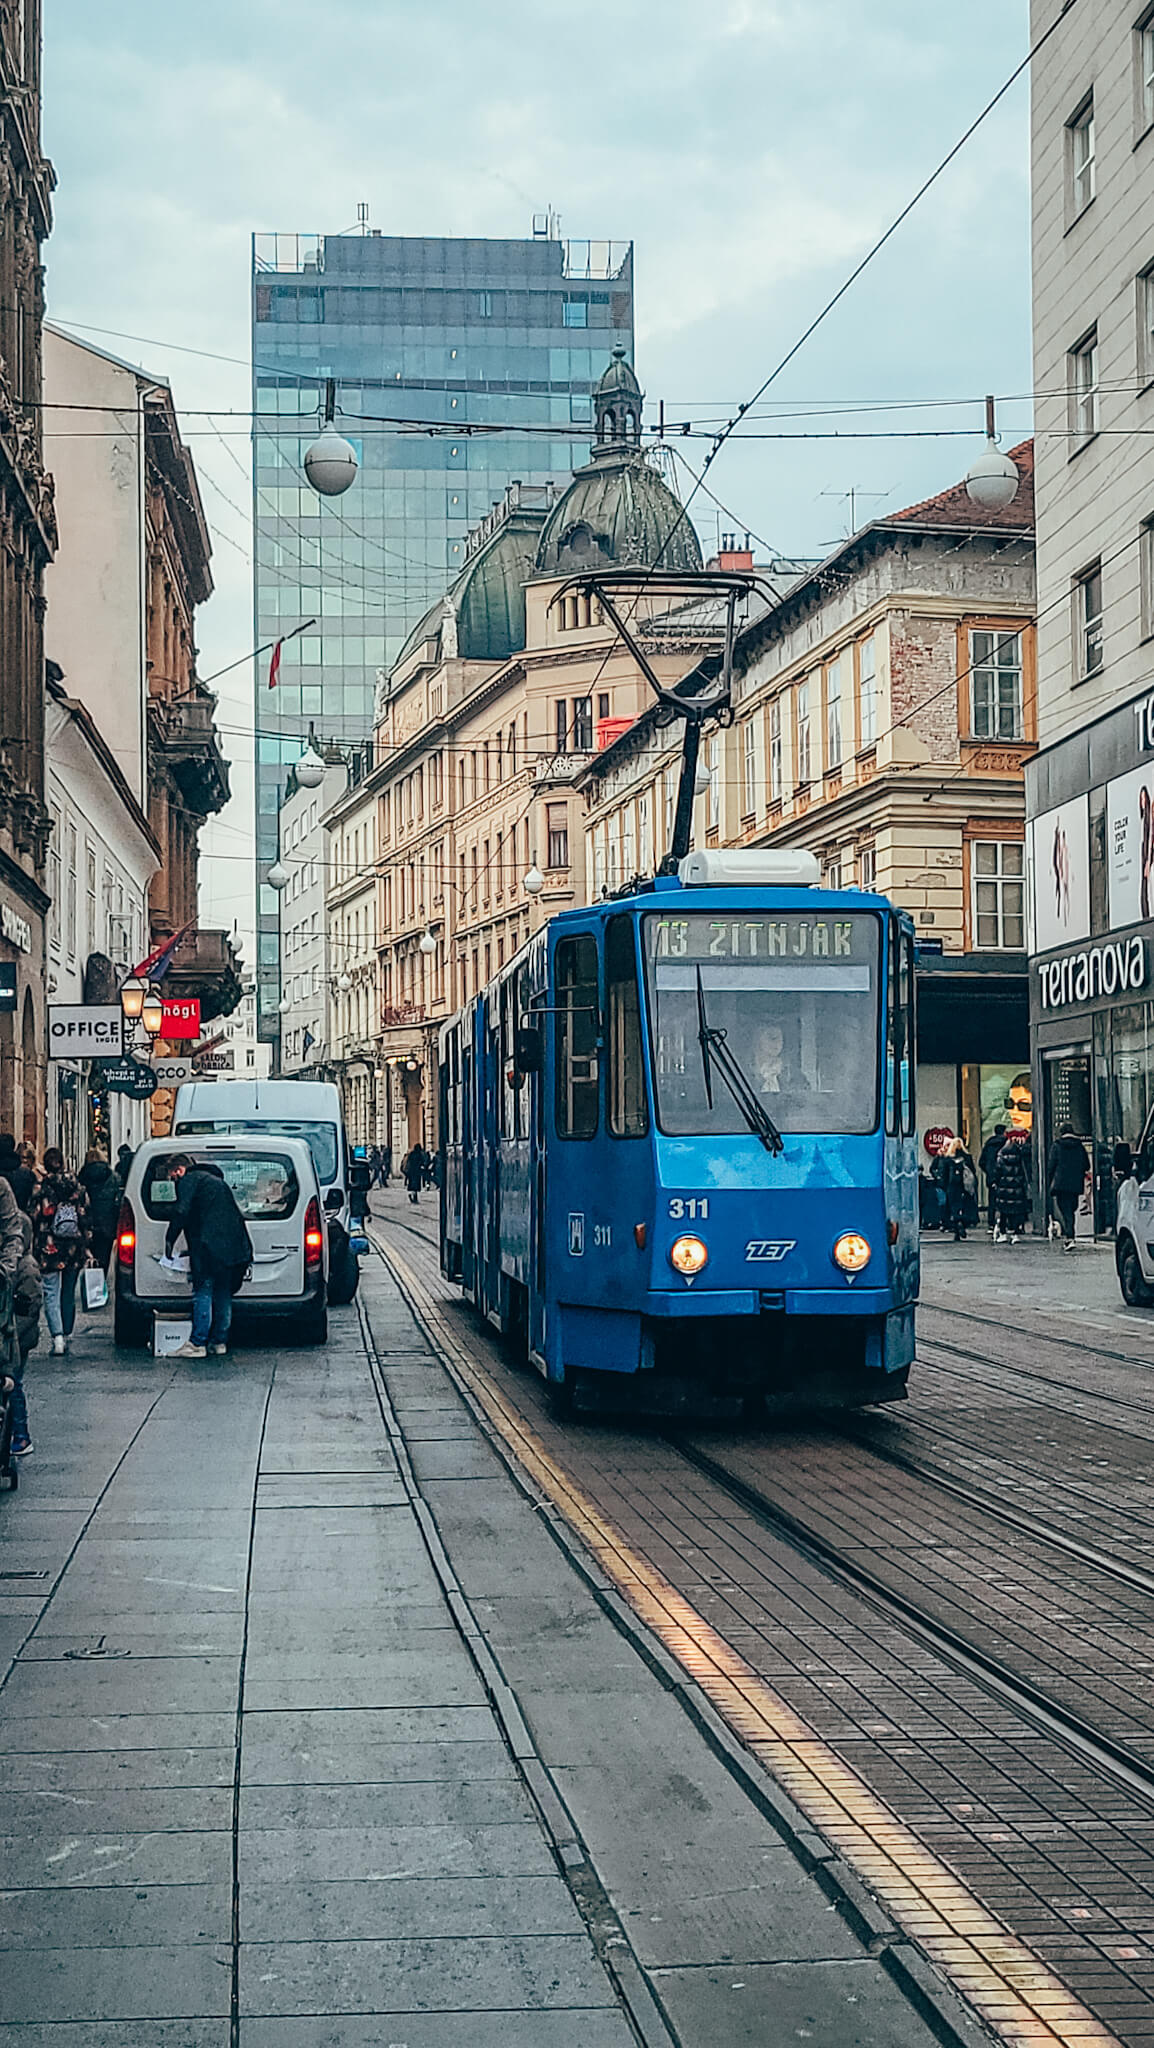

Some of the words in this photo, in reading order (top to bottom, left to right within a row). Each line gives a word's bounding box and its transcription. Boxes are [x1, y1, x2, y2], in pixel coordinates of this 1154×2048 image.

[657, 922, 688, 956] 13
[51, 1021, 119, 1037] OFFICE
[669, 1198, 708, 1219] 311
[593, 1226, 612, 1246] 311
[746, 1240, 797, 1261] ZET
